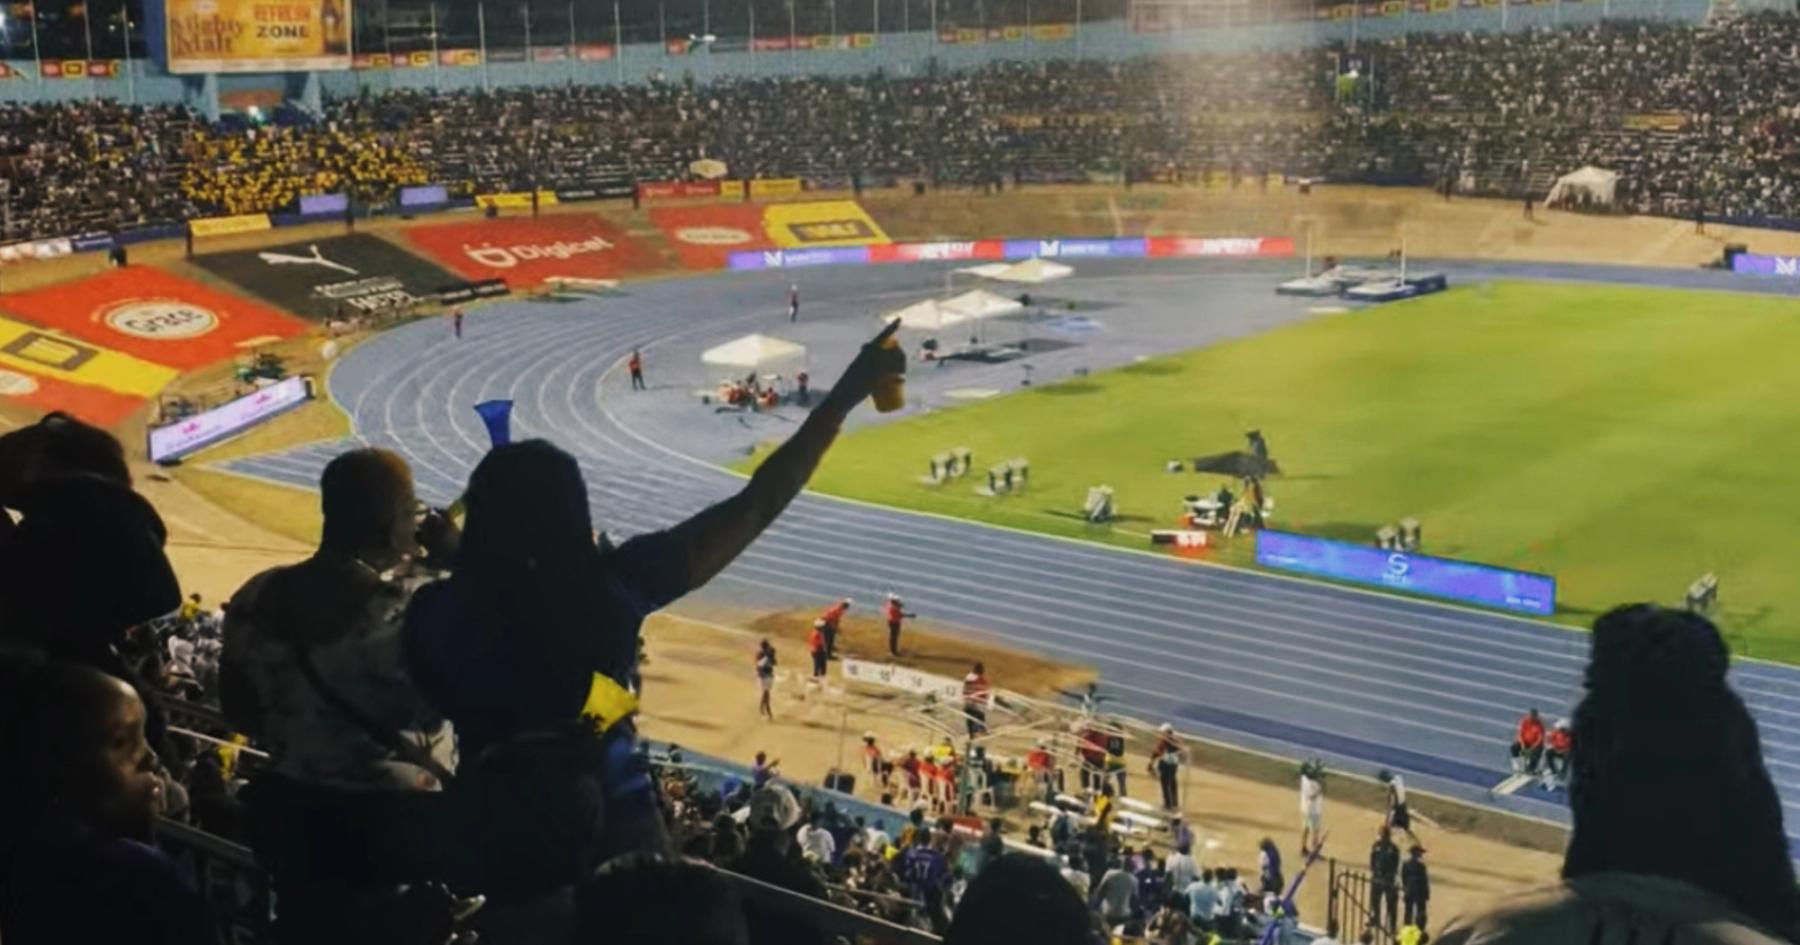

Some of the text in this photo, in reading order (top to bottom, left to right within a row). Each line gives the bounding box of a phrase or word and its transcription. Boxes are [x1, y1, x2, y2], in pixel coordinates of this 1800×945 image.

[256, 25, 309, 39] ZONE
[511, 235, 614, 260] Digicel
[124, 309, 204, 332] Grace
[914, 860, 930, 879] 17
